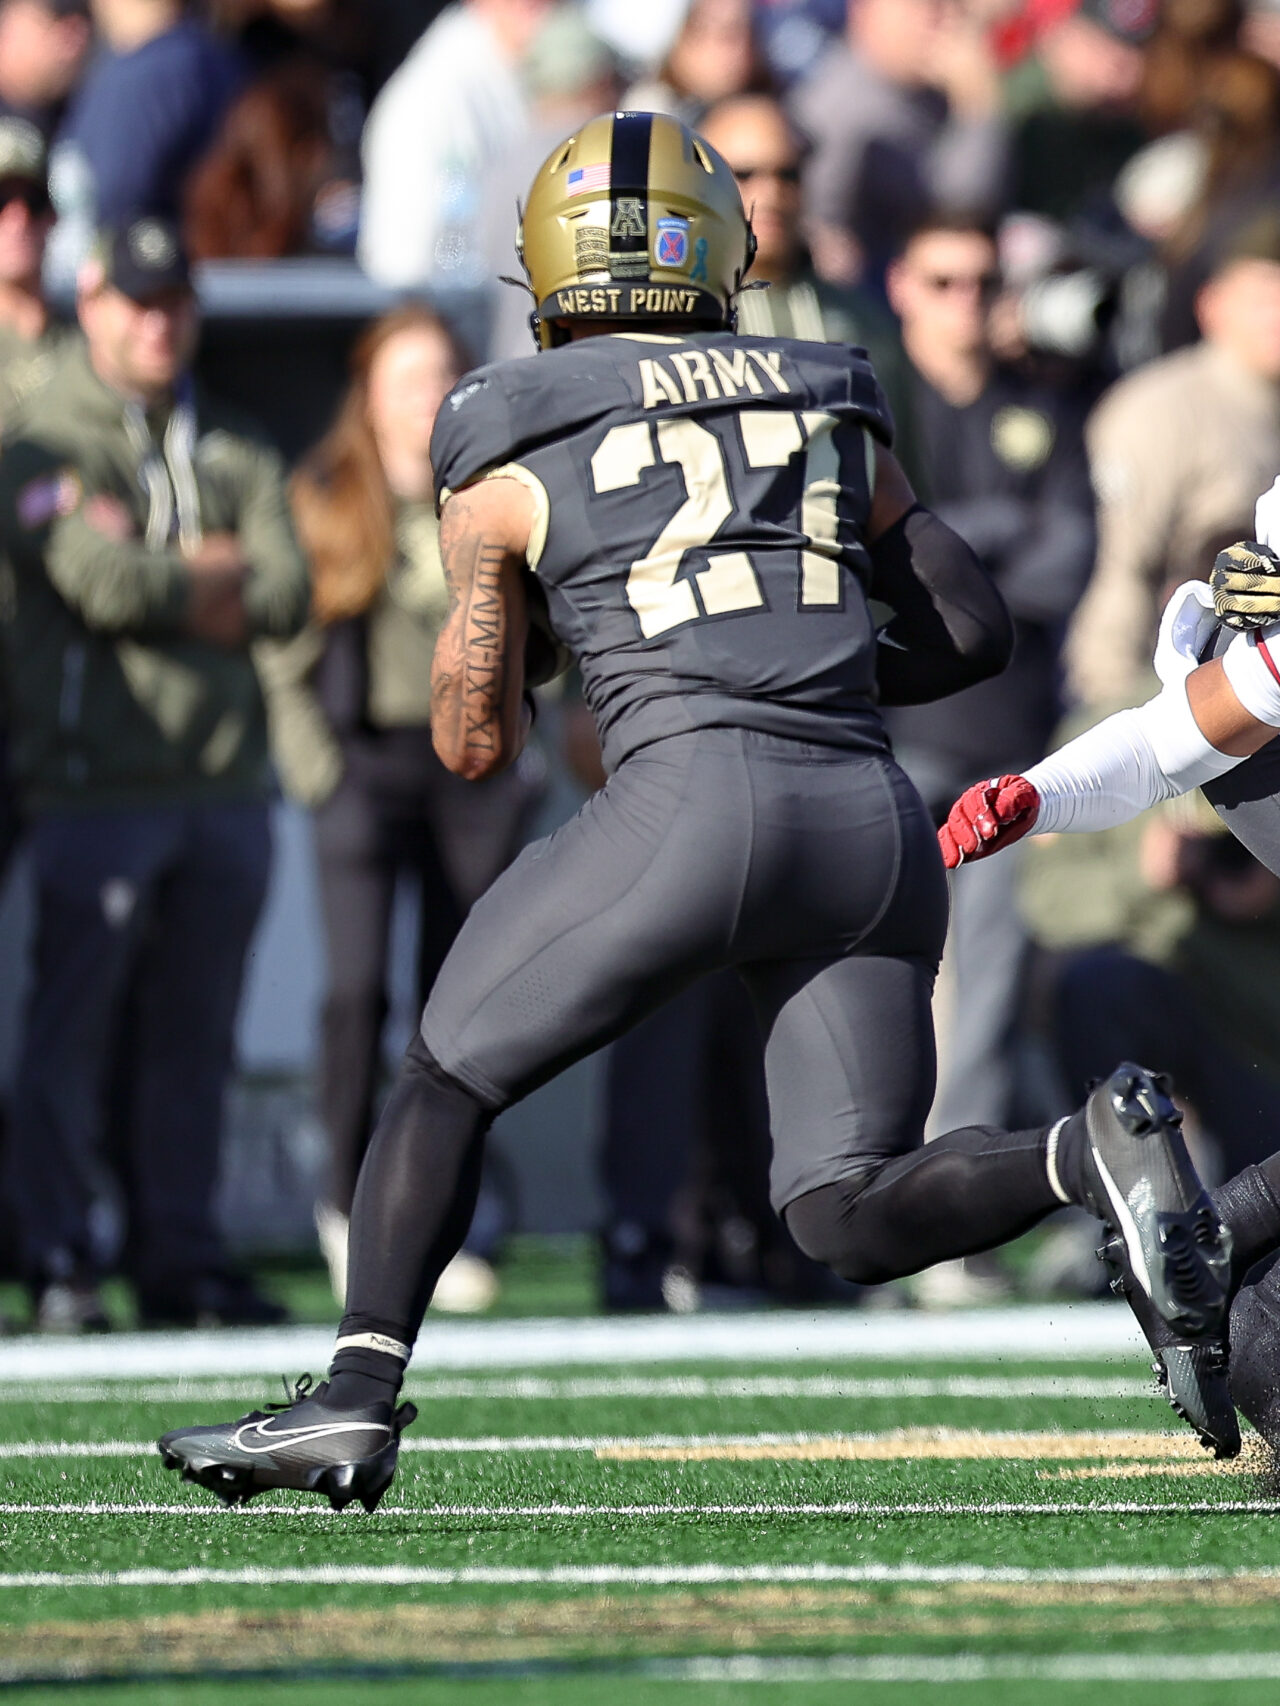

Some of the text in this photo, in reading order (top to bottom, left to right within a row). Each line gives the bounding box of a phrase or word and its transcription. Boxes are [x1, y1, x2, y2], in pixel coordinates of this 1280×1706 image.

[556, 288, 701, 314] WEST POINT
[638, 348, 791, 410] ARMY
[588, 409, 842, 640] 27
